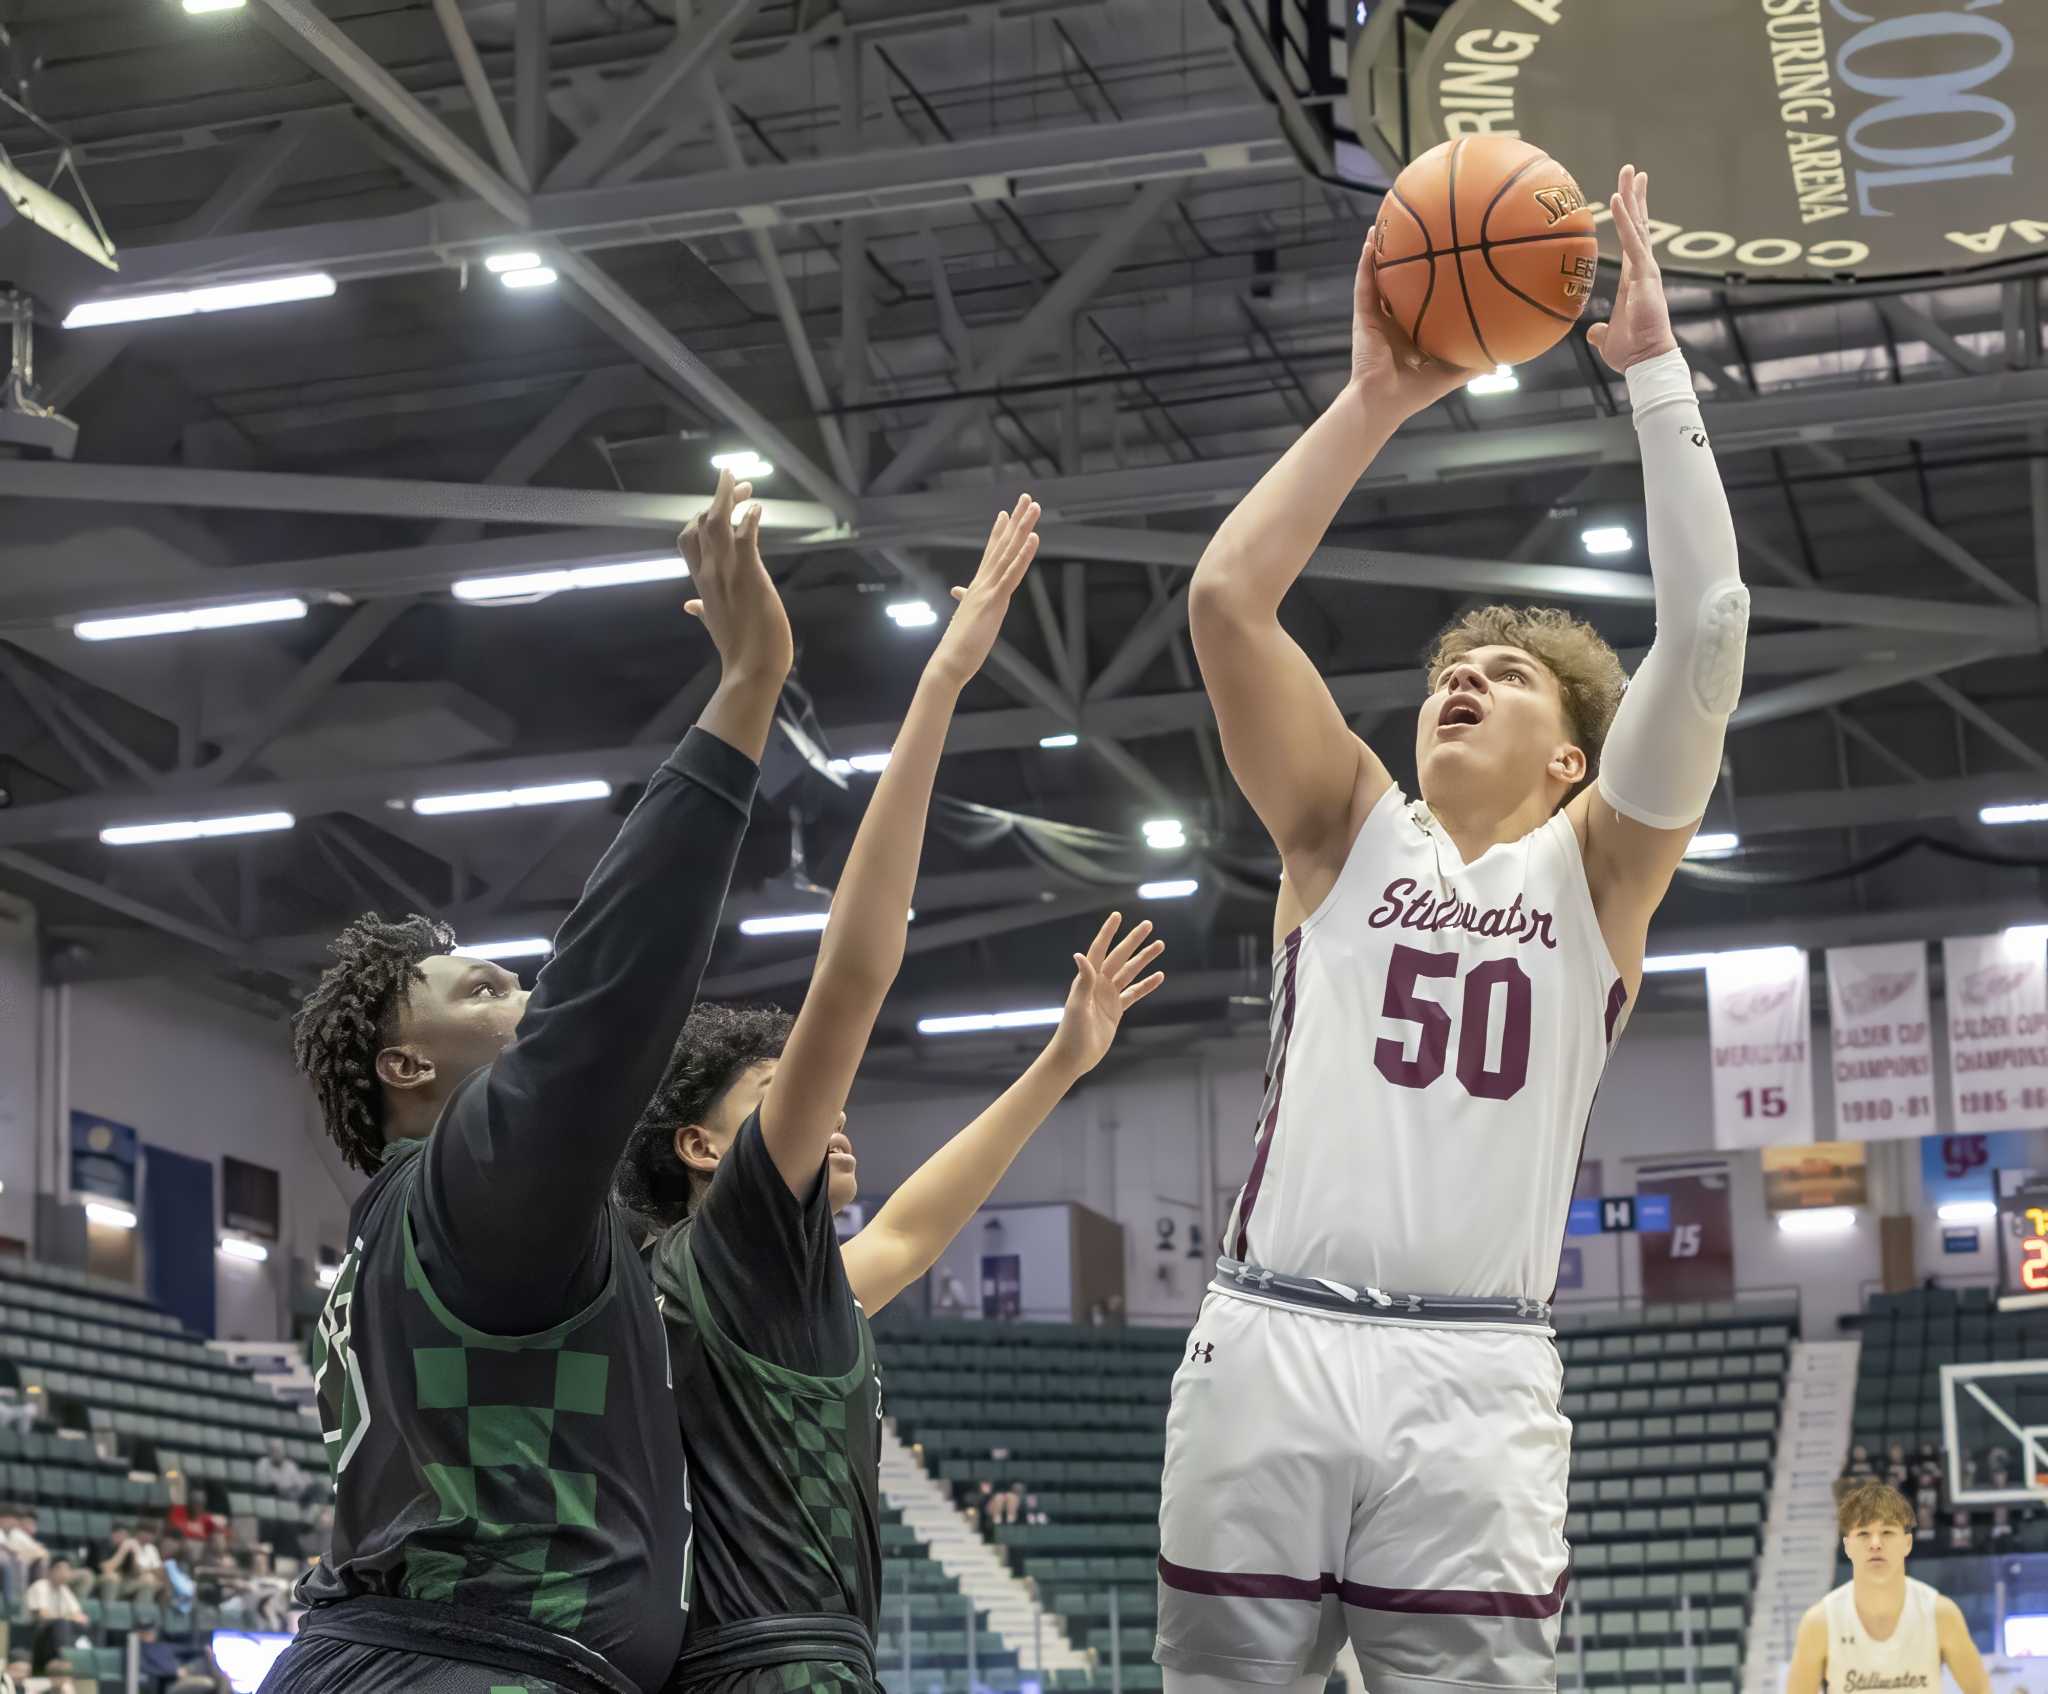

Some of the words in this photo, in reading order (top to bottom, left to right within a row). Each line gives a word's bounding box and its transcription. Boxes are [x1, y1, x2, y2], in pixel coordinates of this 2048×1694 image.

[1761, 0, 1837, 123] SURING
[1829, 0, 2016, 216] OOL
[1785, 130, 1849, 224] ARENA
[1373, 943, 1532, 1101] 50
[1836, 1055, 1929, 1083] CHAMPIONS
[1736, 1086, 1788, 1119] 15
[1605, 1202, 1631, 1228] H
[1670, 1225, 1703, 1258] 15
[1843, 1669, 1928, 1694] Stillwater
